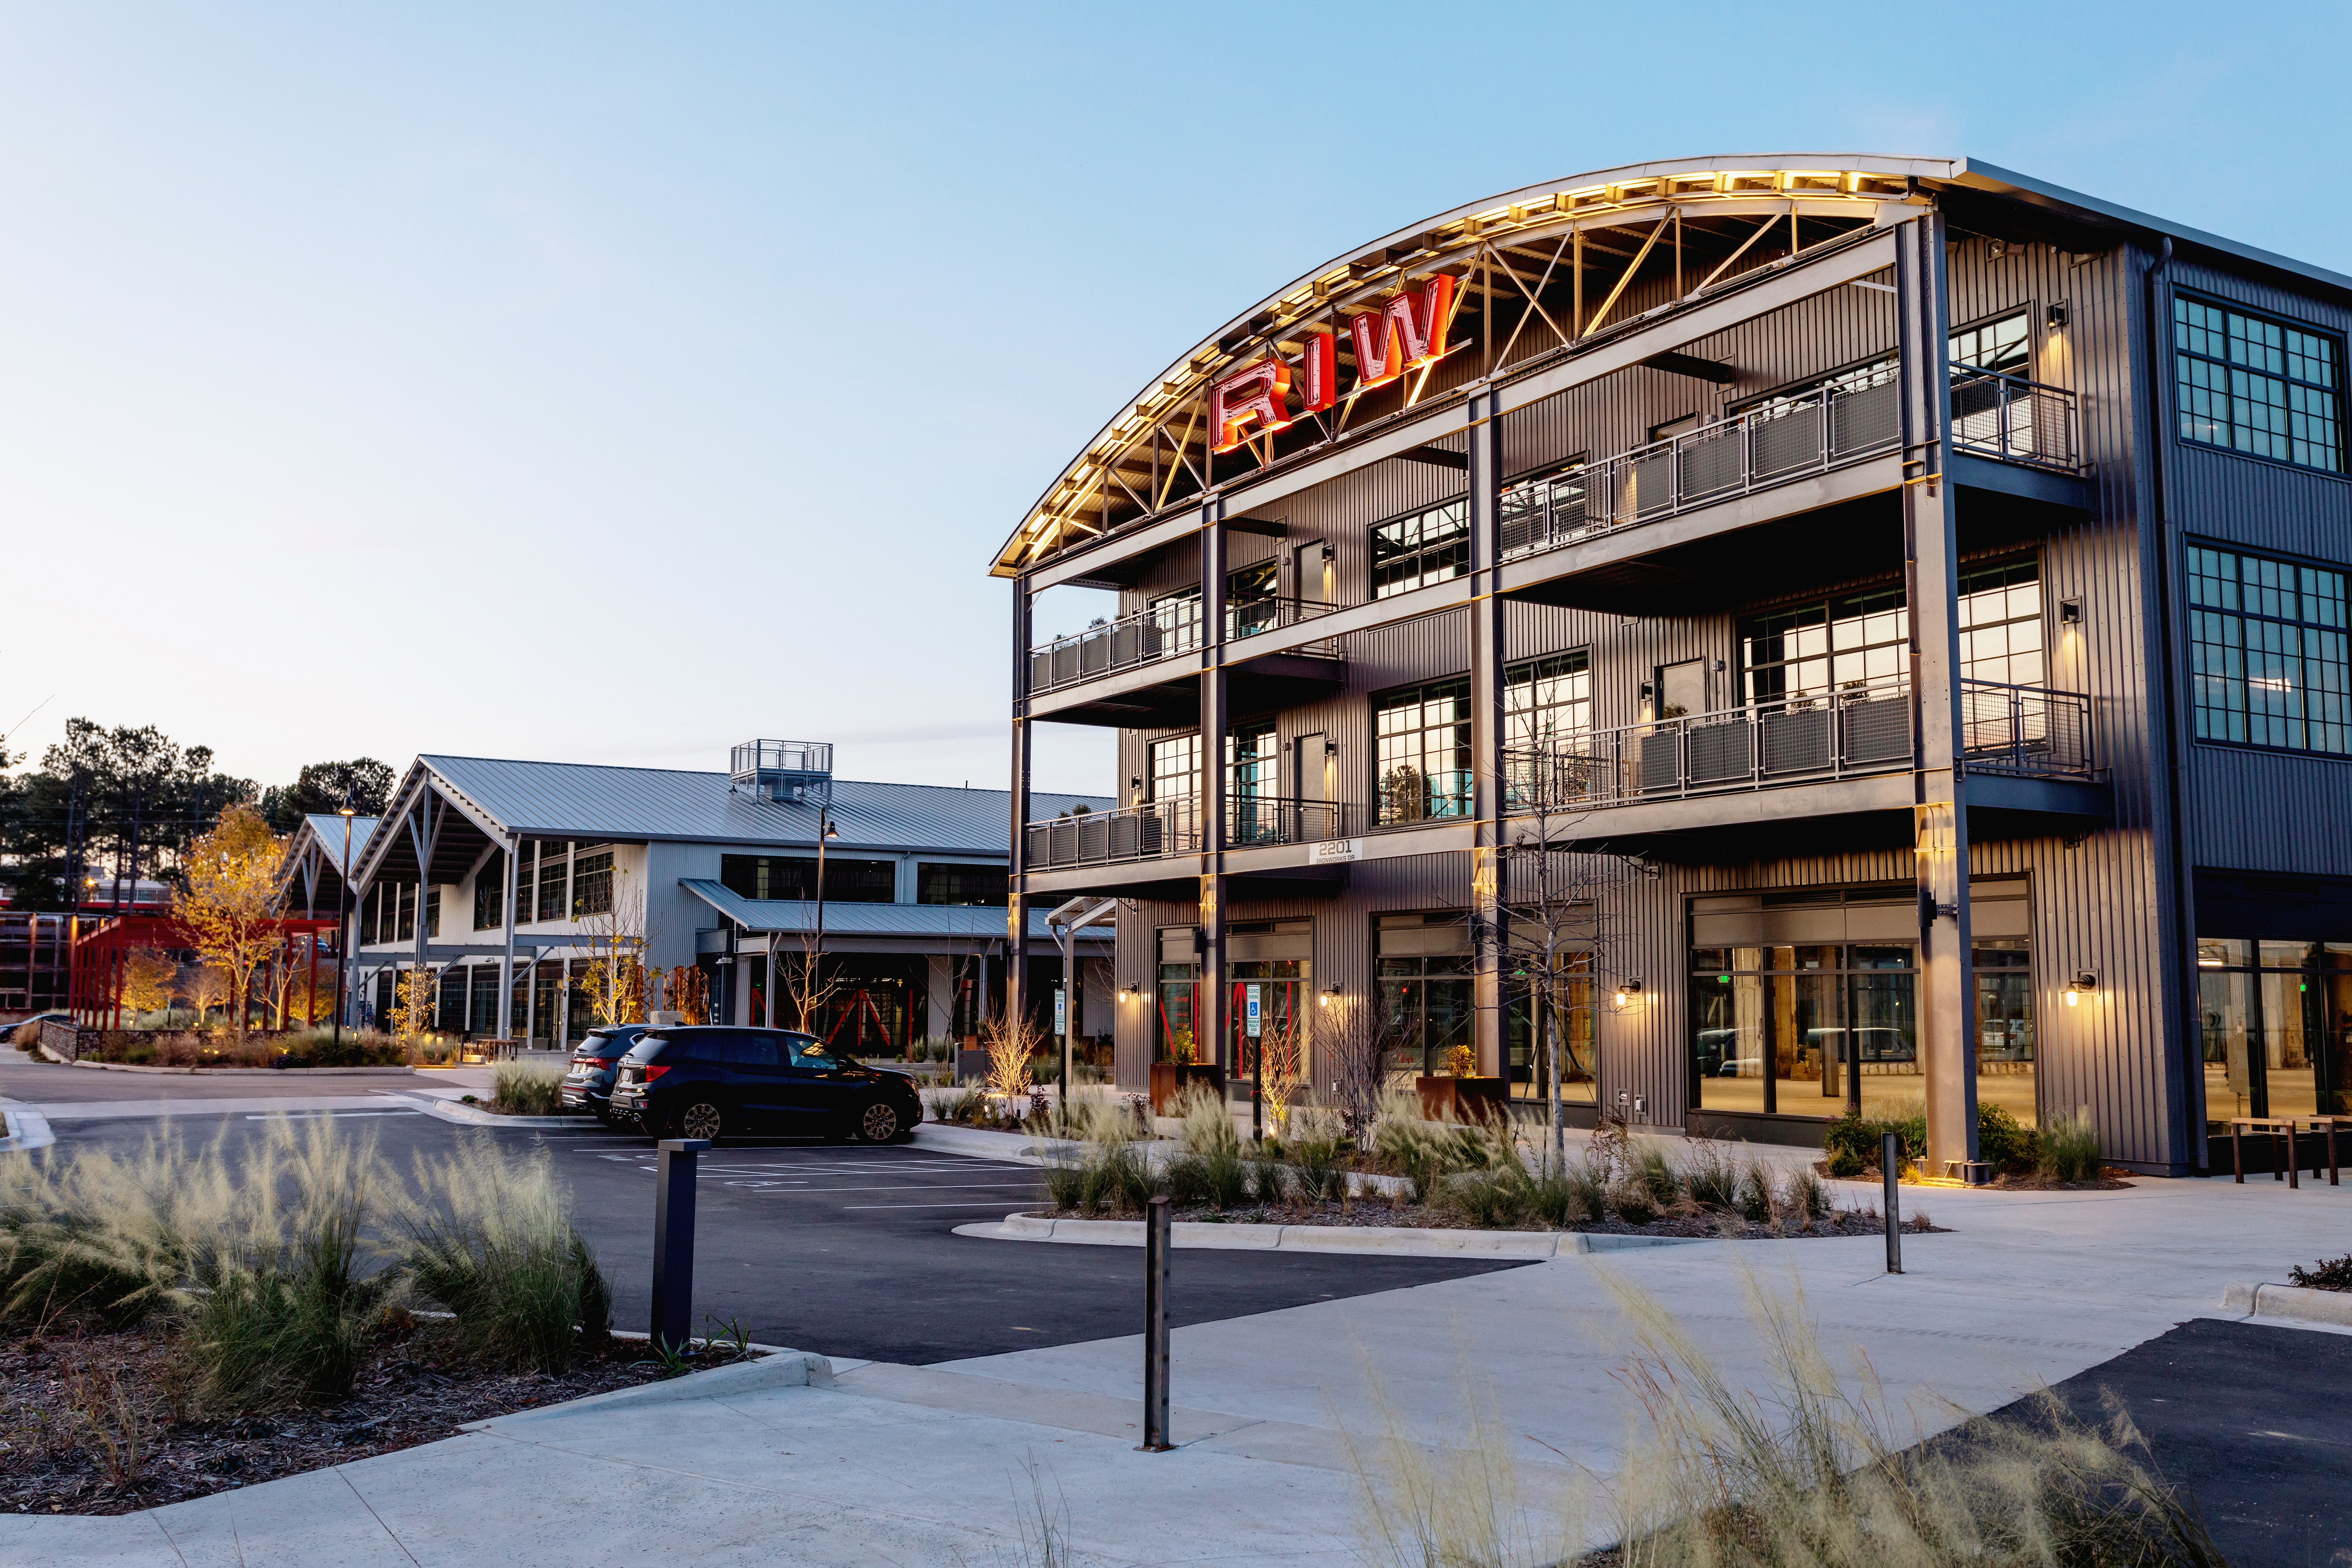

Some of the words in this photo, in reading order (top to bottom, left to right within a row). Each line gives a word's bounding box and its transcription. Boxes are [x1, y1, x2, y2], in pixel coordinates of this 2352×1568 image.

[1209, 273, 1456, 453] RIW
[1319, 840, 1351, 856] 2201
[1316, 856, 1346, 864] IRONWORKS
